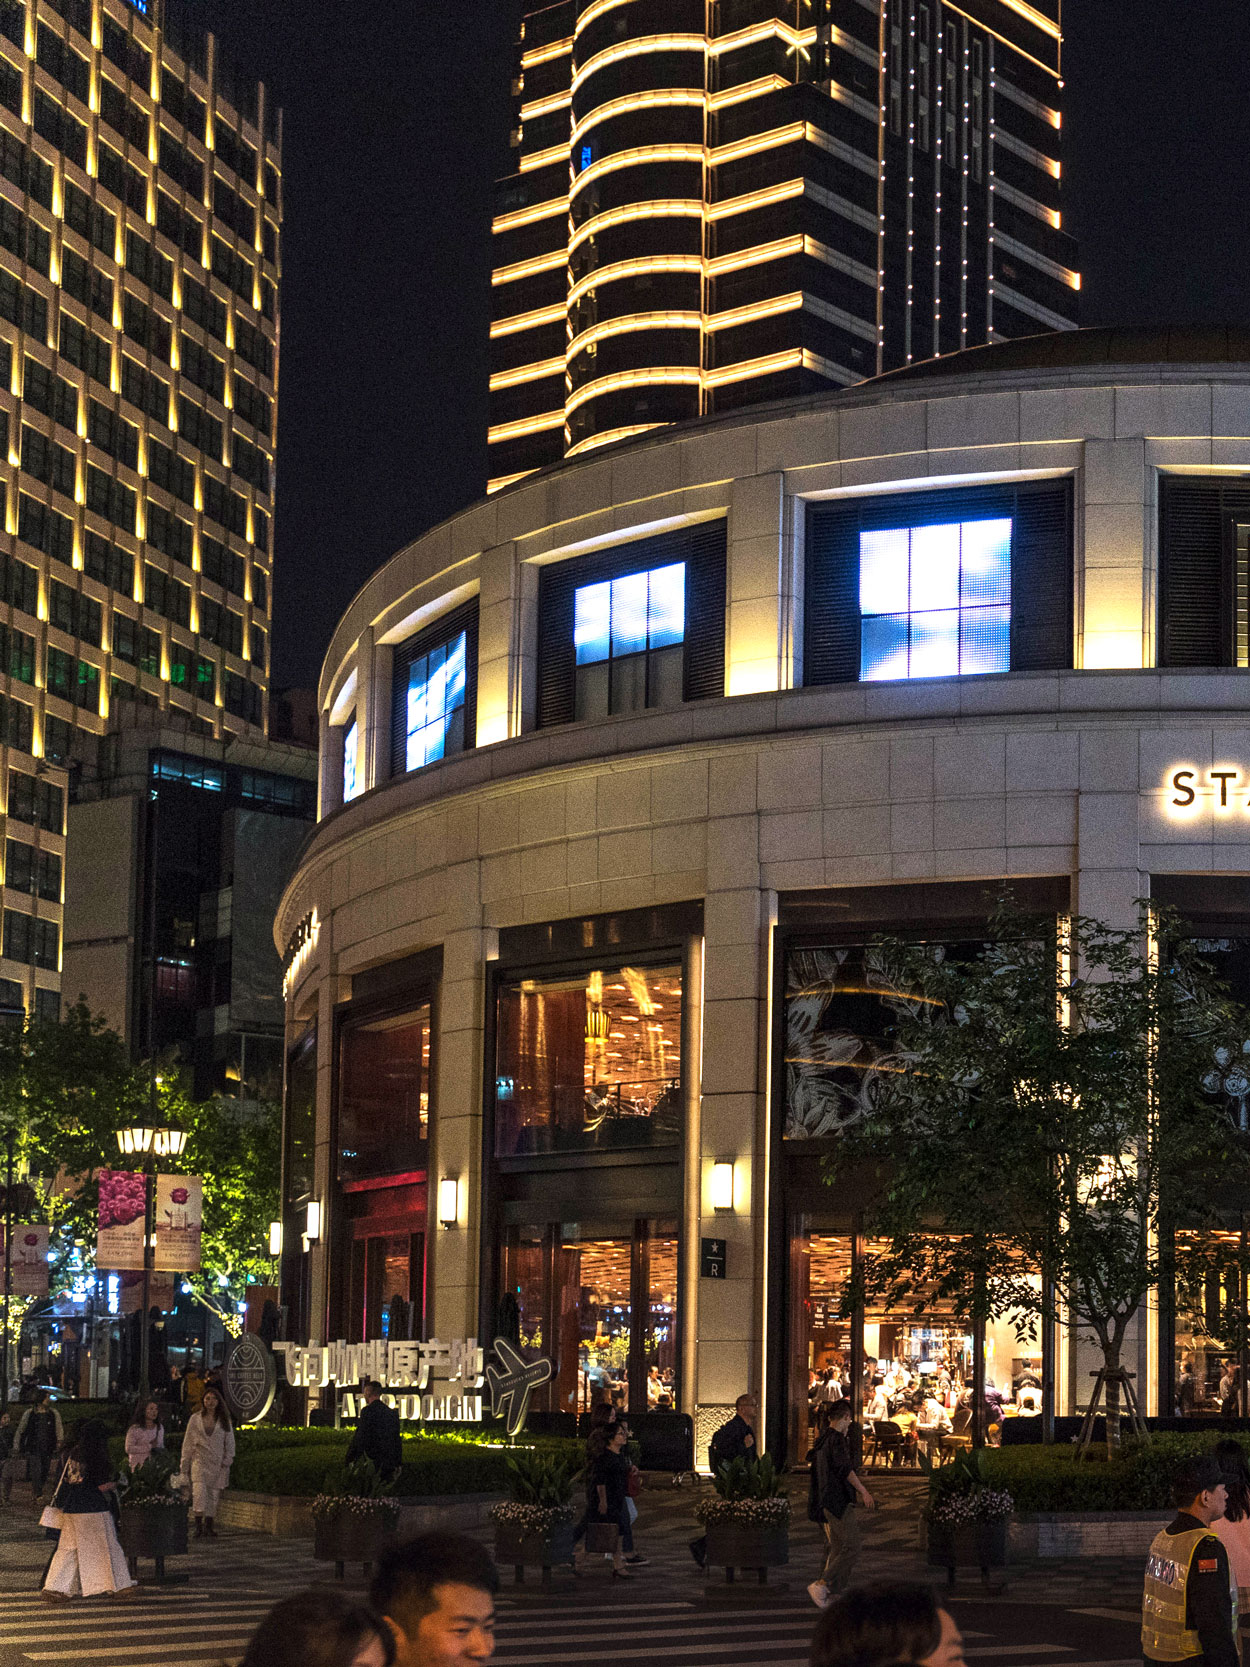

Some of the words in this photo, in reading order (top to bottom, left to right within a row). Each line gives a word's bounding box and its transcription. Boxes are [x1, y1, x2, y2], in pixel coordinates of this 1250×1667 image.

[710, 1262, 719, 1277] R
[271, 1338, 485, 1389] 飞向咖啡原产地
